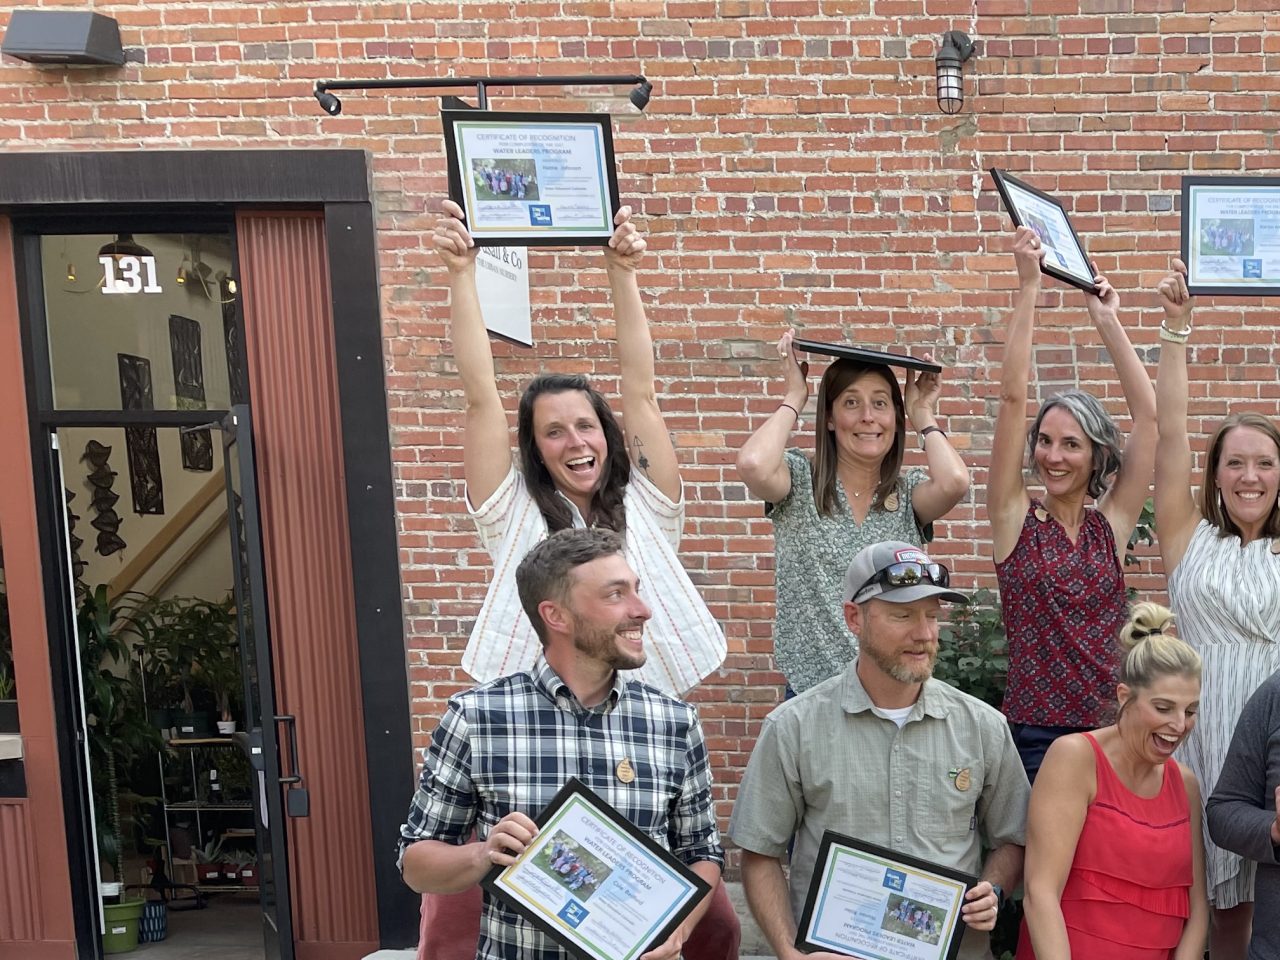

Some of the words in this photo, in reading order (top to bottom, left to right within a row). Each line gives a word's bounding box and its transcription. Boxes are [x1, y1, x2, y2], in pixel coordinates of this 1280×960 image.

[502, 246, 510, 264] &
[510, 251, 522, 269] Co
[98, 256, 163, 294] 131
